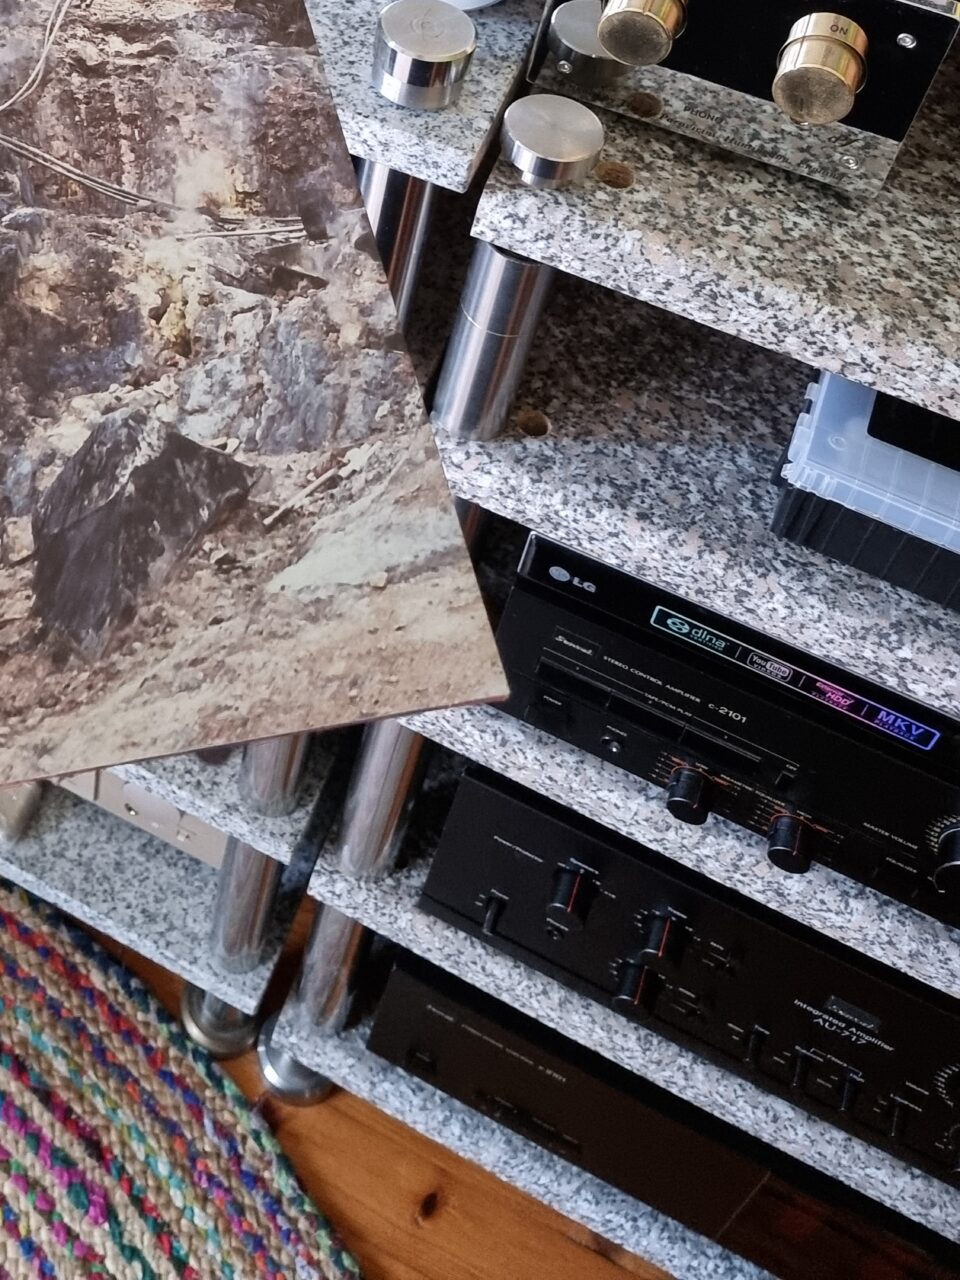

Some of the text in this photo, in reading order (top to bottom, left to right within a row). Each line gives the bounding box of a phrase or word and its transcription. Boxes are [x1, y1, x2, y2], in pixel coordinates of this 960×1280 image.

[830, 24, 848, 35] ON
[572, 576, 597, 593] LG
[691, 626, 727, 648] dlna
[603, 655, 629, 670] STEREO
[630, 668, 663, 686] CONTROL
[826, 691, 854, 706] HDD
[877, 710, 925, 736] MKV
[794, 999, 895, 1052] Integrated Amplifier
[813, 1018, 867, 1044] AU-717
